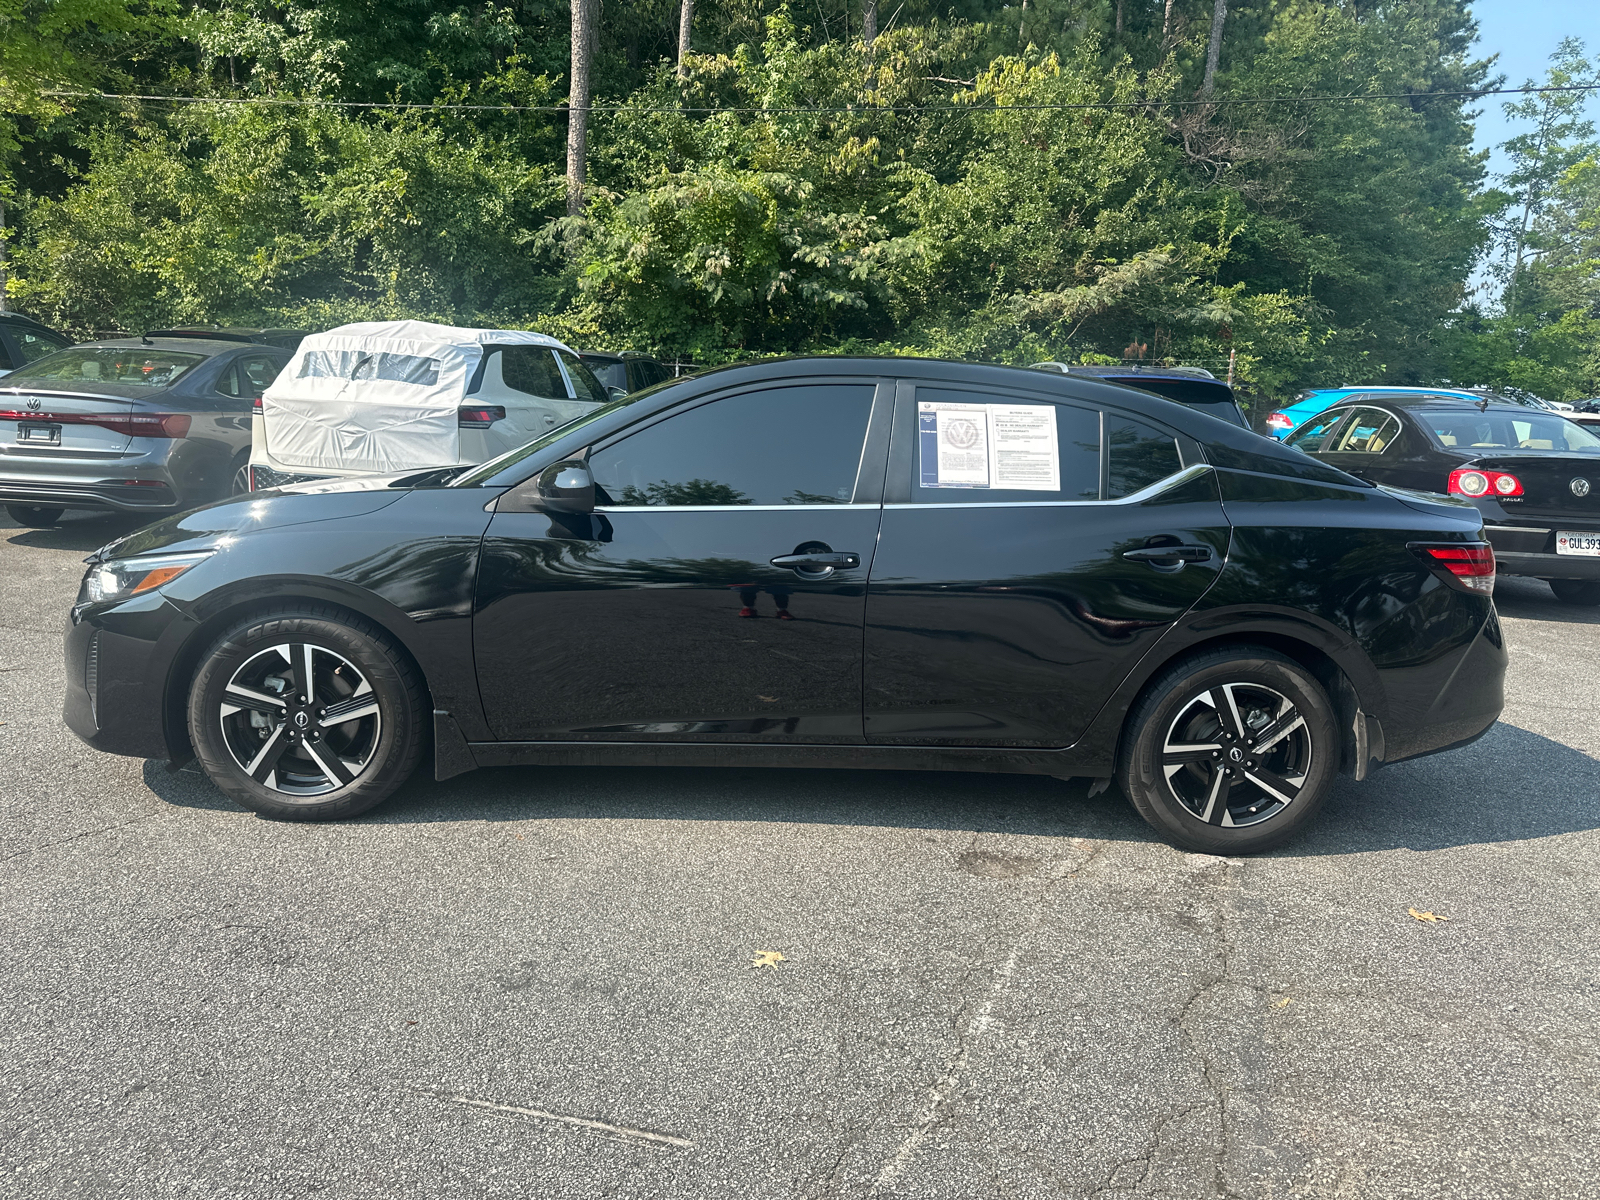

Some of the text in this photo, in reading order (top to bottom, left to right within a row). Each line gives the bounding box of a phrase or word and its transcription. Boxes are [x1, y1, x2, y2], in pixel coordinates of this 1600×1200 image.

[1568, 537, 1600, 550] GUL393
[246, 618, 368, 652] SENTURY
[194, 671, 212, 746] TOURING
[386, 694, 403, 771] 205/60R16
